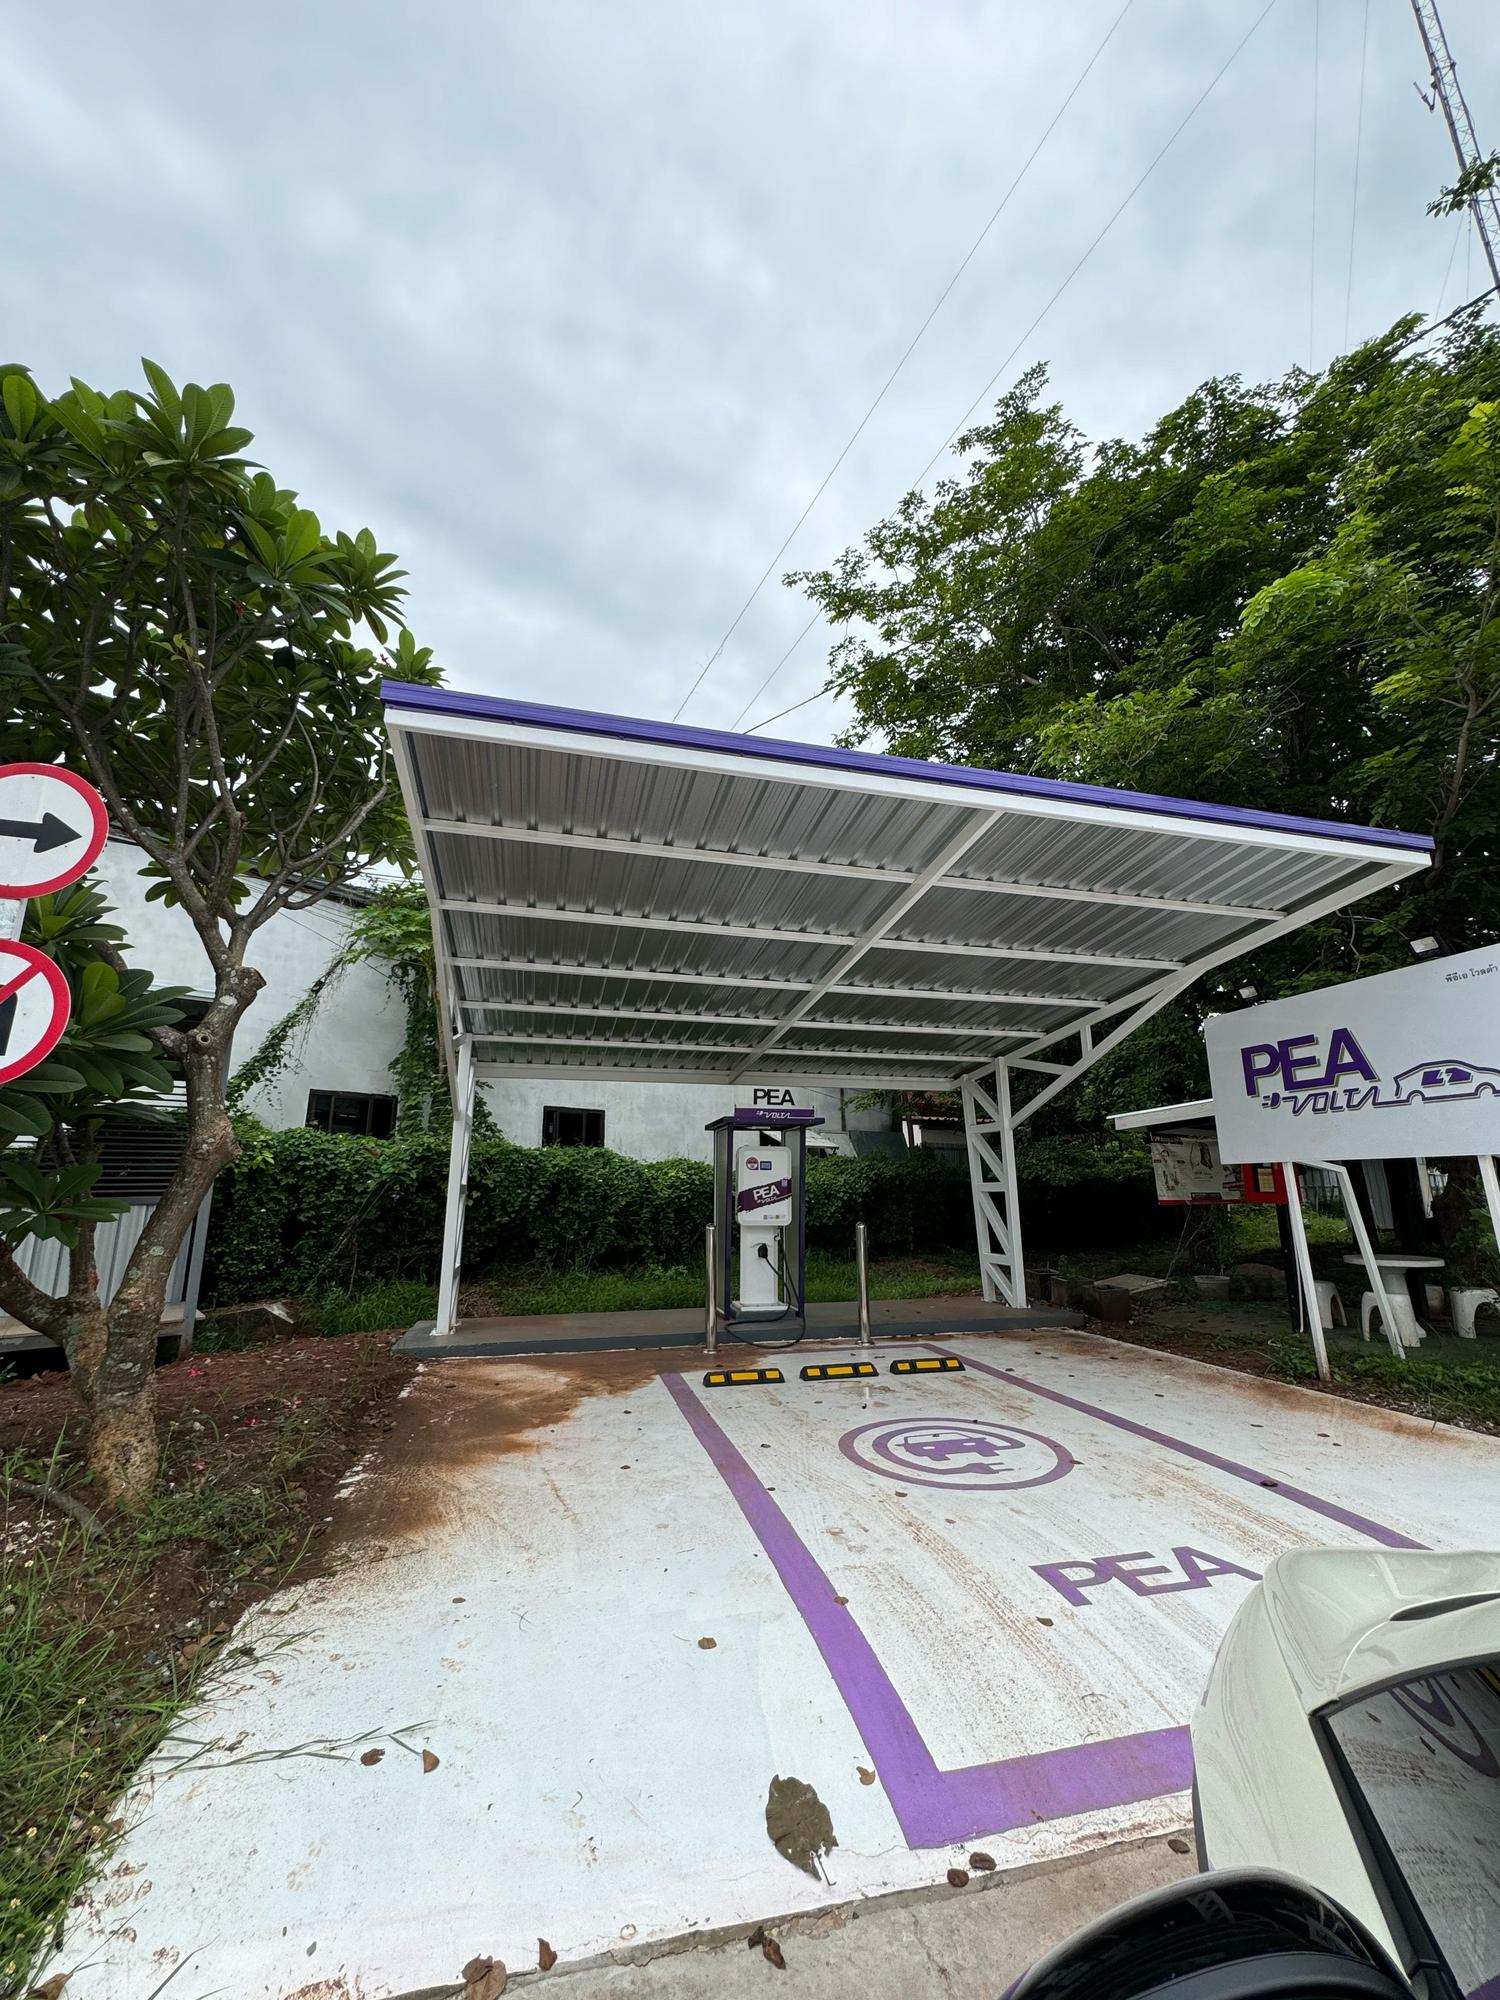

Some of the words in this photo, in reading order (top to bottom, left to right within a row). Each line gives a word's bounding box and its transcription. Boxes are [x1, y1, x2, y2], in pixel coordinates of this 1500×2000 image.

[1241, 1027, 1379, 1097] PEA
[753, 1088, 795, 1106] PEA
[1284, 1085, 1379, 1115] VOLTA
[764, 1111, 791, 1119] VOLTA
[753, 1184, 780, 1201] PEA
[1029, 1546, 1264, 1608] PEA
